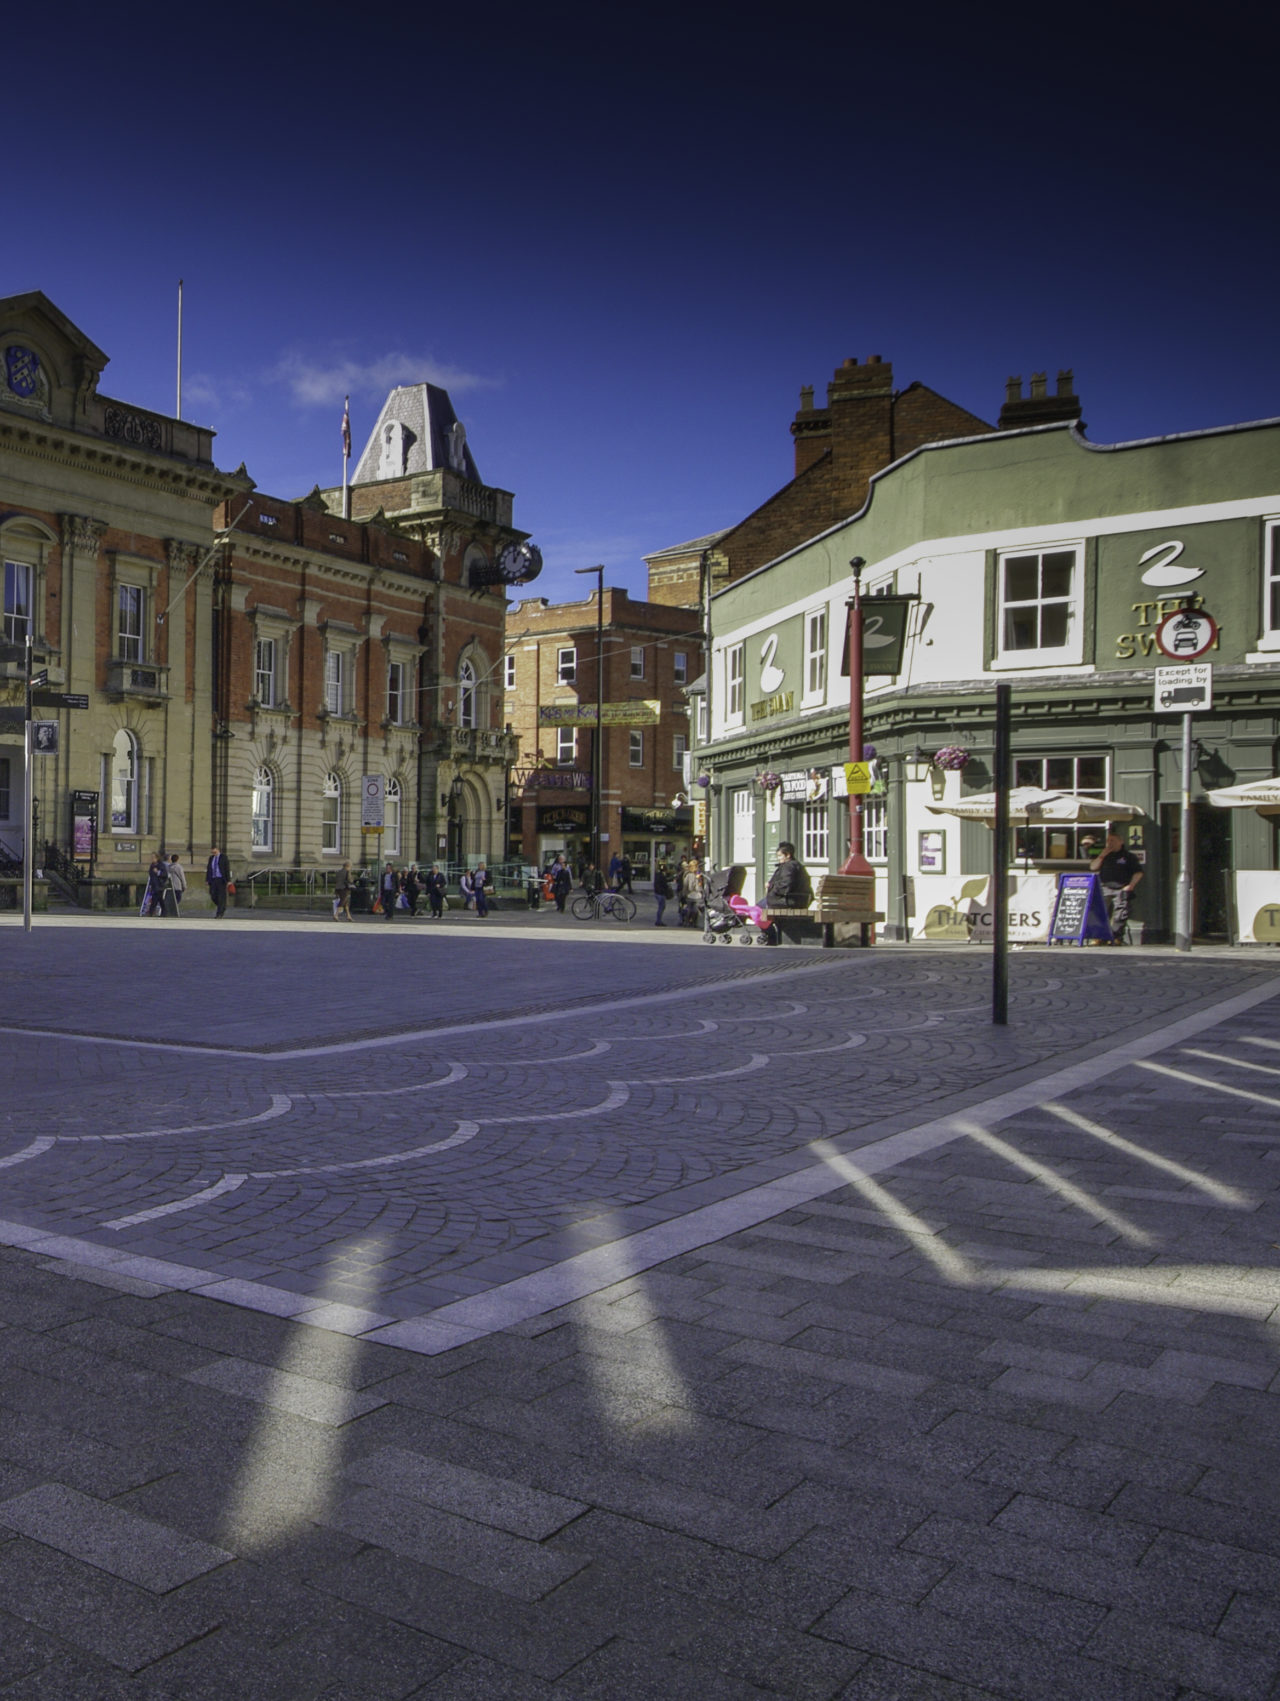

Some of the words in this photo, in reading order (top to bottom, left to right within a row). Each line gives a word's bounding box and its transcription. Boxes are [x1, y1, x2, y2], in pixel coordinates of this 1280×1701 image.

[1130, 597, 1205, 627] TH
[1158, 668, 1191, 677] Except
[1194, 666, 1208, 674] for
[1158, 677, 1193, 686] loading
[1196, 676, 1208, 684] by
[768, 691, 794, 717] SWAN
[933, 910, 1042, 928] THATCERS
